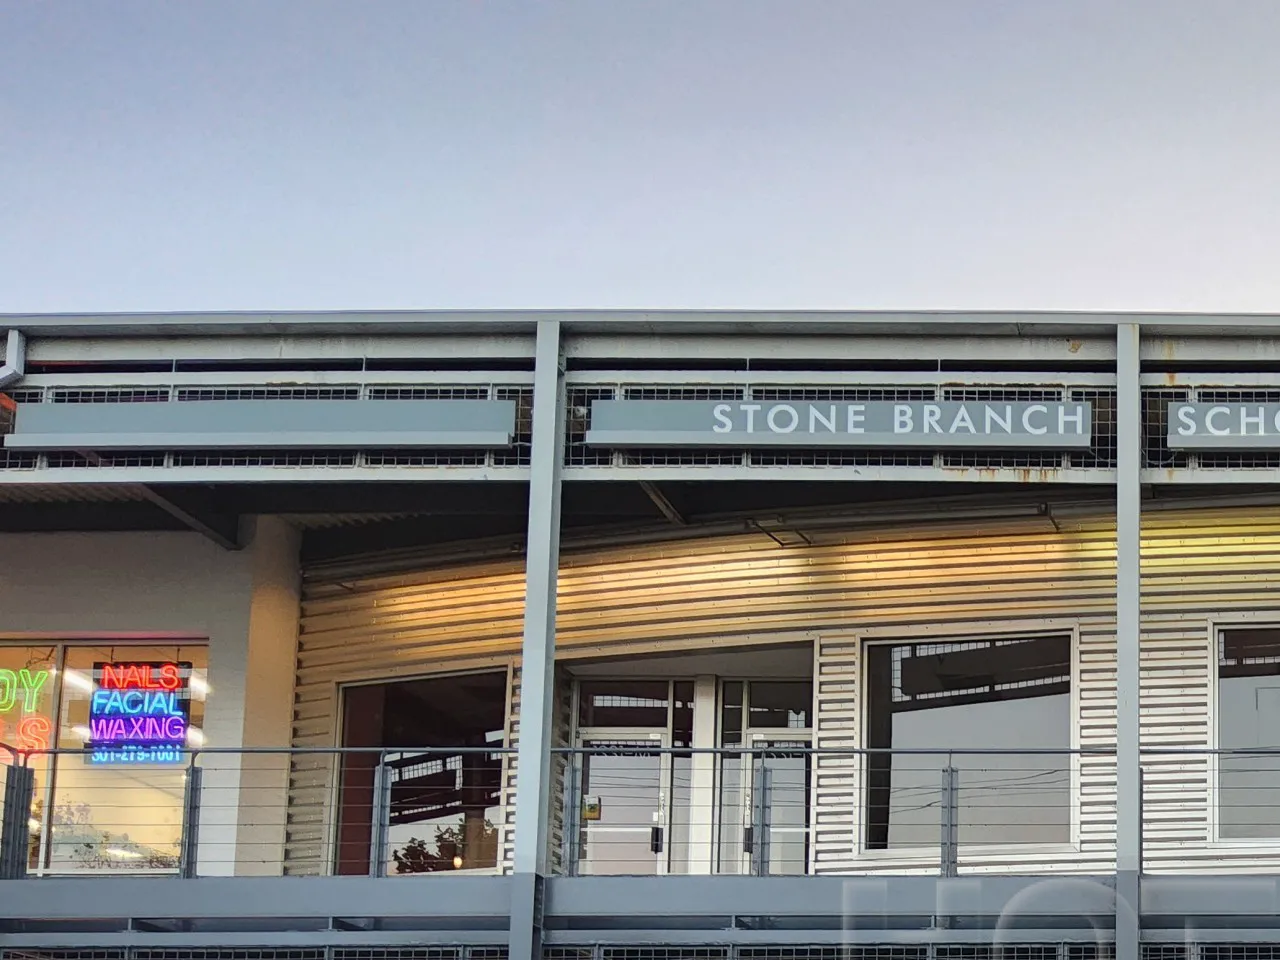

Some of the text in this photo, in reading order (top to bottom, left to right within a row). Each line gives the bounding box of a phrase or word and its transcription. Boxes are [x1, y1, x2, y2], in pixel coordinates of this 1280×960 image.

[712, 404, 1084, 434] STONE BRANCH
[104, 665, 180, 689] NAILS
[92, 690, 184, 716] FACIAL
[91, 716, 185, 740] WAXING
